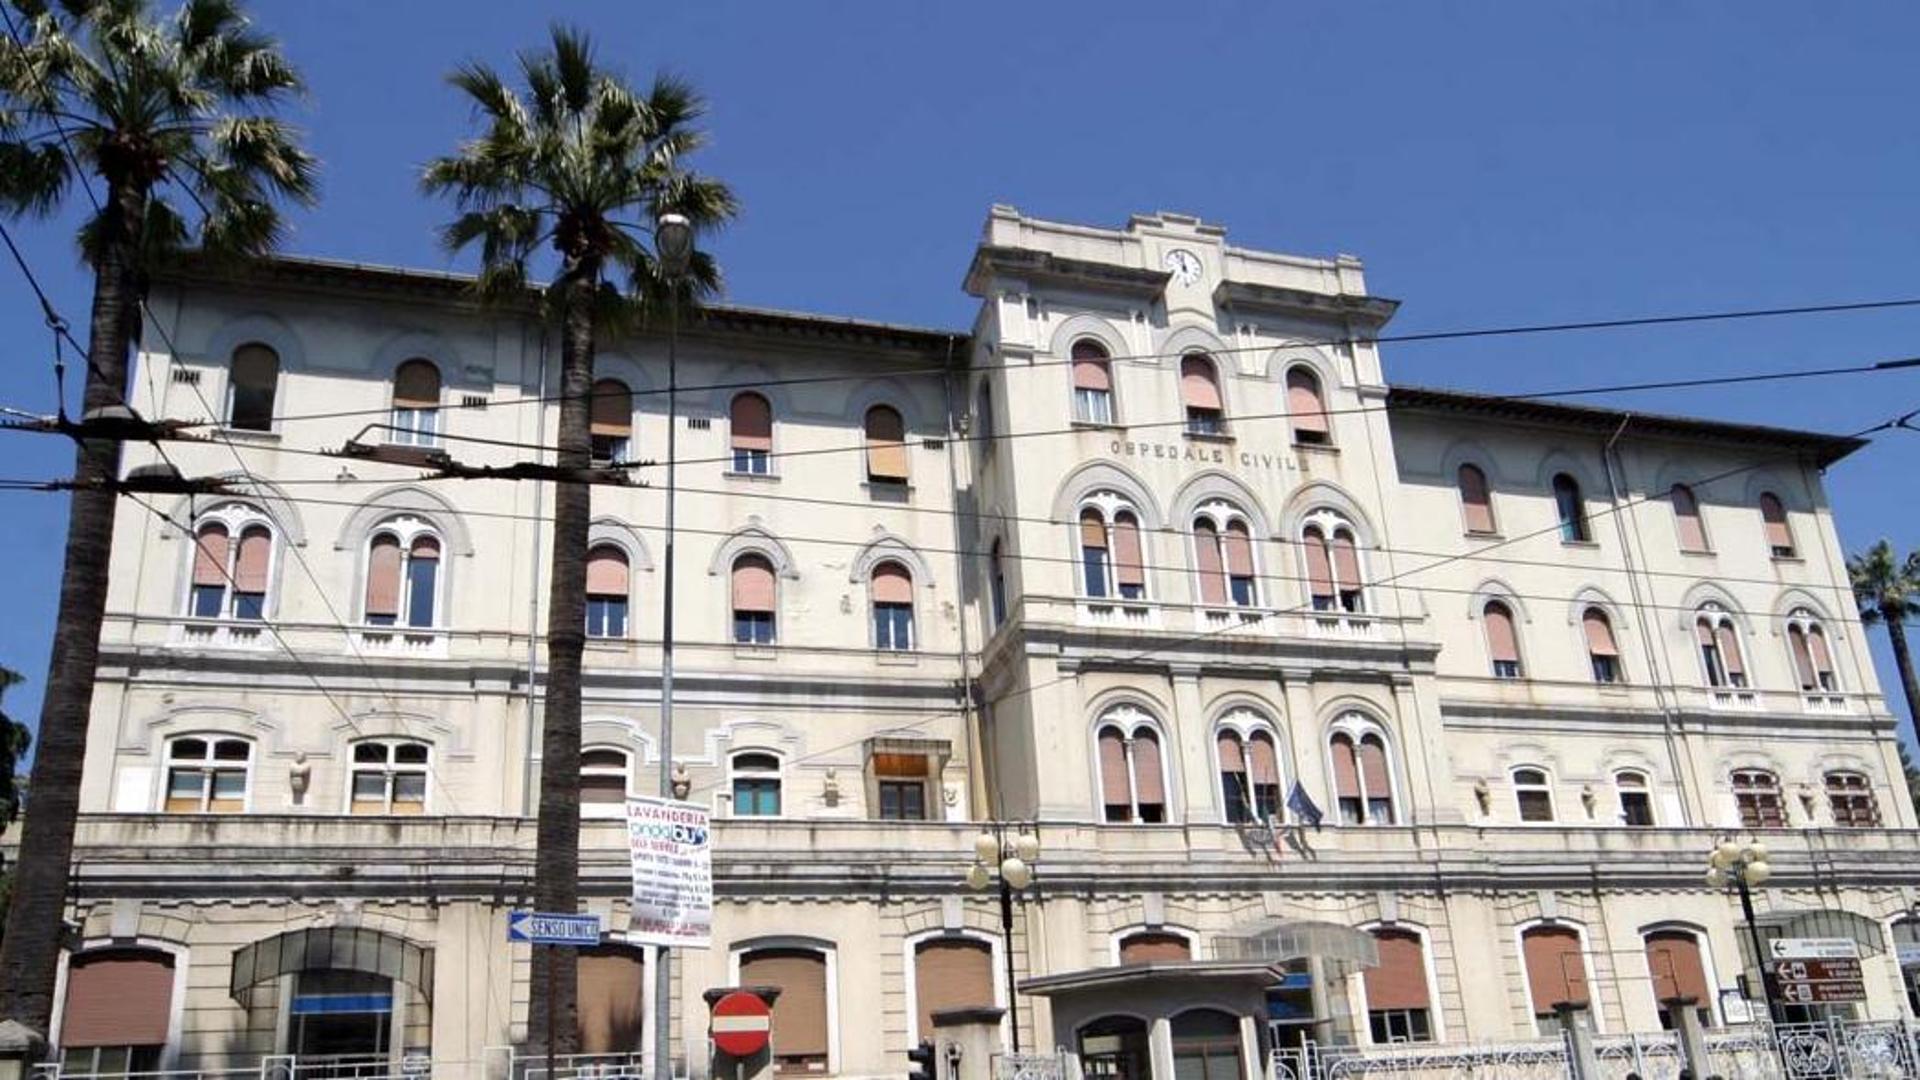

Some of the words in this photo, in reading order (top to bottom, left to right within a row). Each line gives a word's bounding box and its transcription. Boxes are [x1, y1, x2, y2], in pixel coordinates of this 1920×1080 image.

[1110, 441, 1224, 463] OSPEDALE
[1240, 452, 1310, 472] CIVILE
[627, 805, 706, 825] LAVANDERIA
[531, 920, 565, 936] SENSO
[568, 921, 599, 937] UNICO
